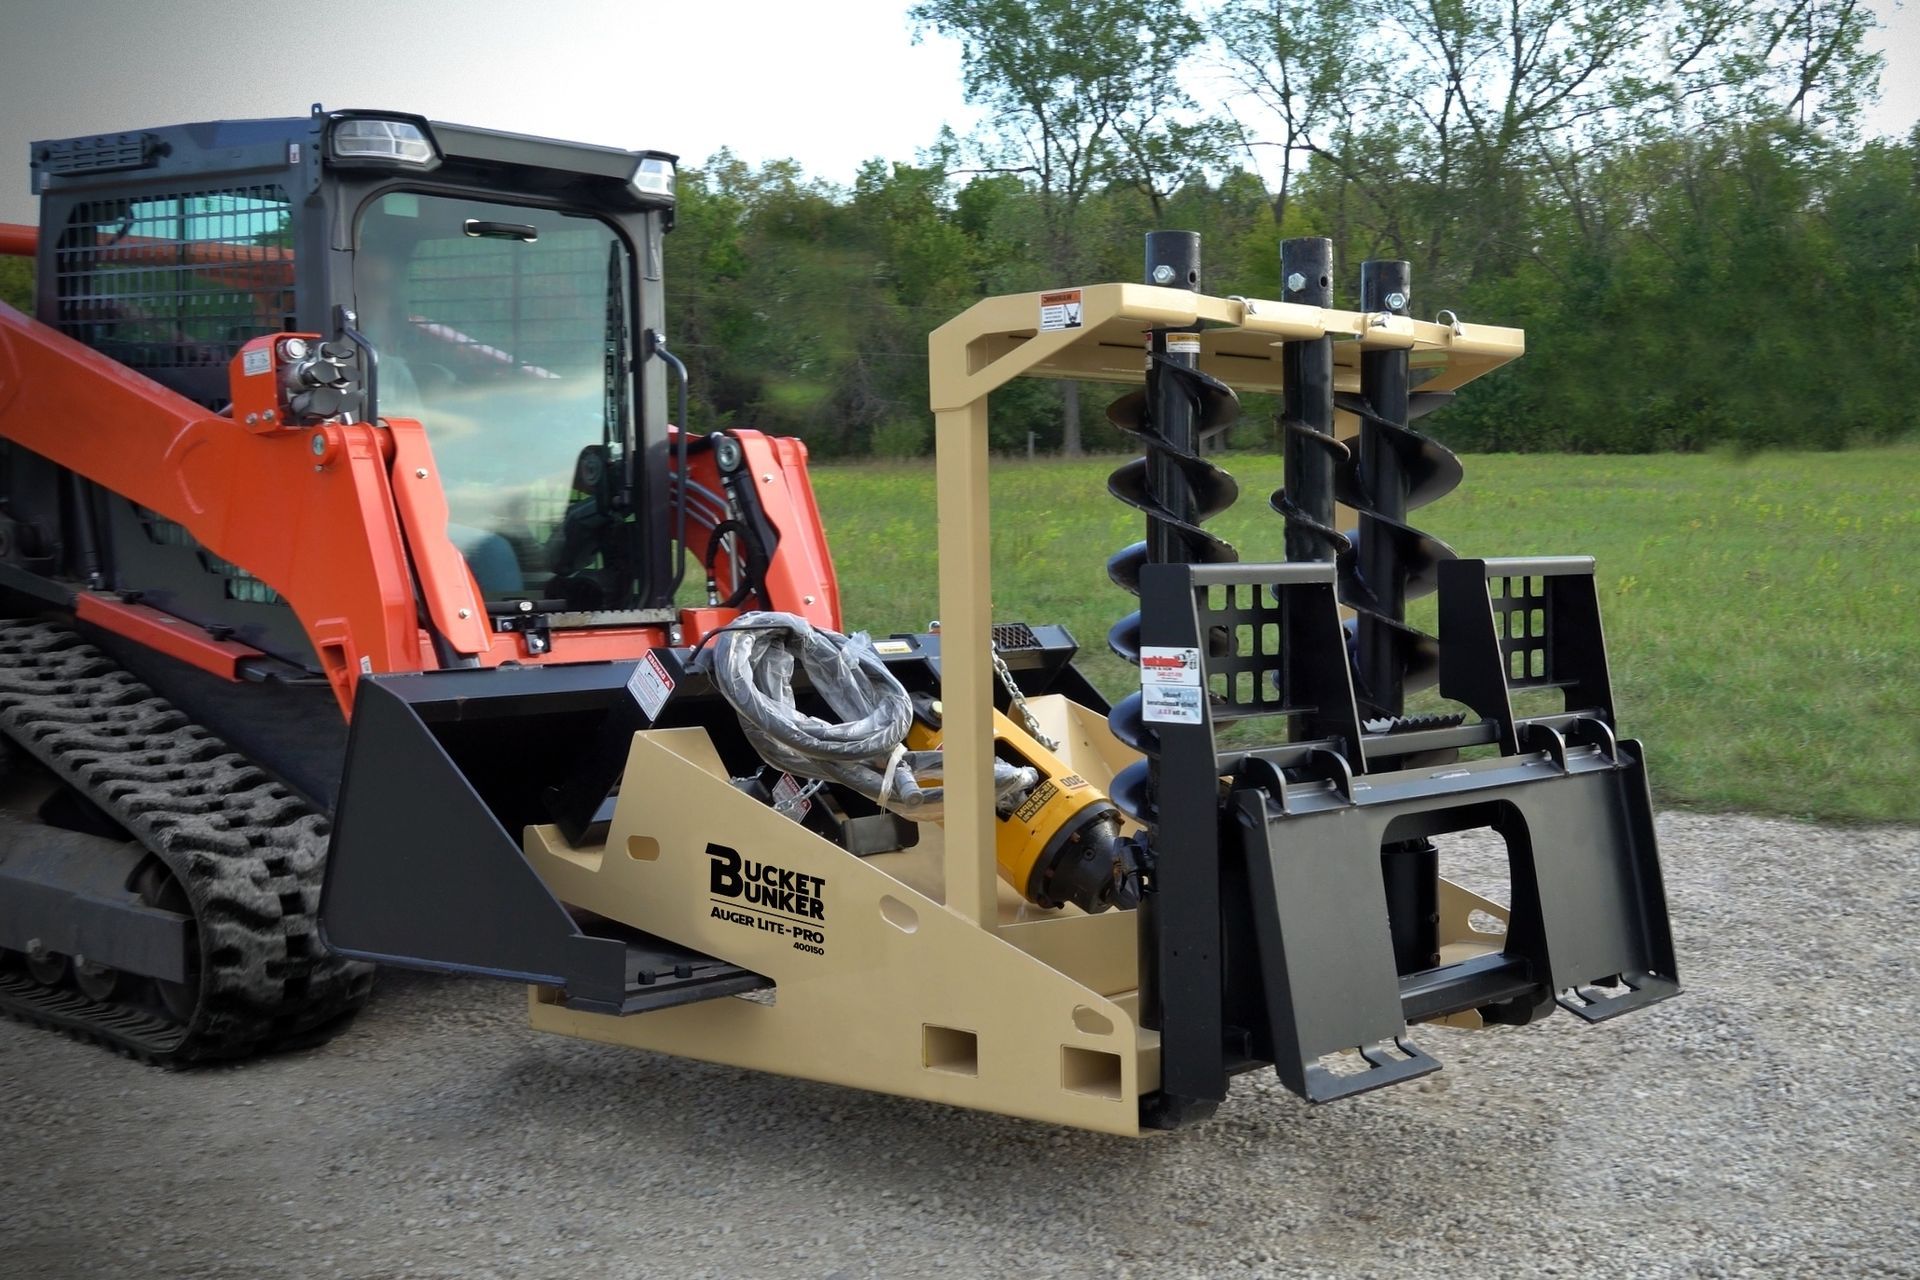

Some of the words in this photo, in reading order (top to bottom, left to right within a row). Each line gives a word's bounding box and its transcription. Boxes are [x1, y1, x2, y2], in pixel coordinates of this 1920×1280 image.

[705, 843, 825, 898] BUCKET
[710, 906, 754, 928] AUGER
[793, 941, 825, 956] 400150
